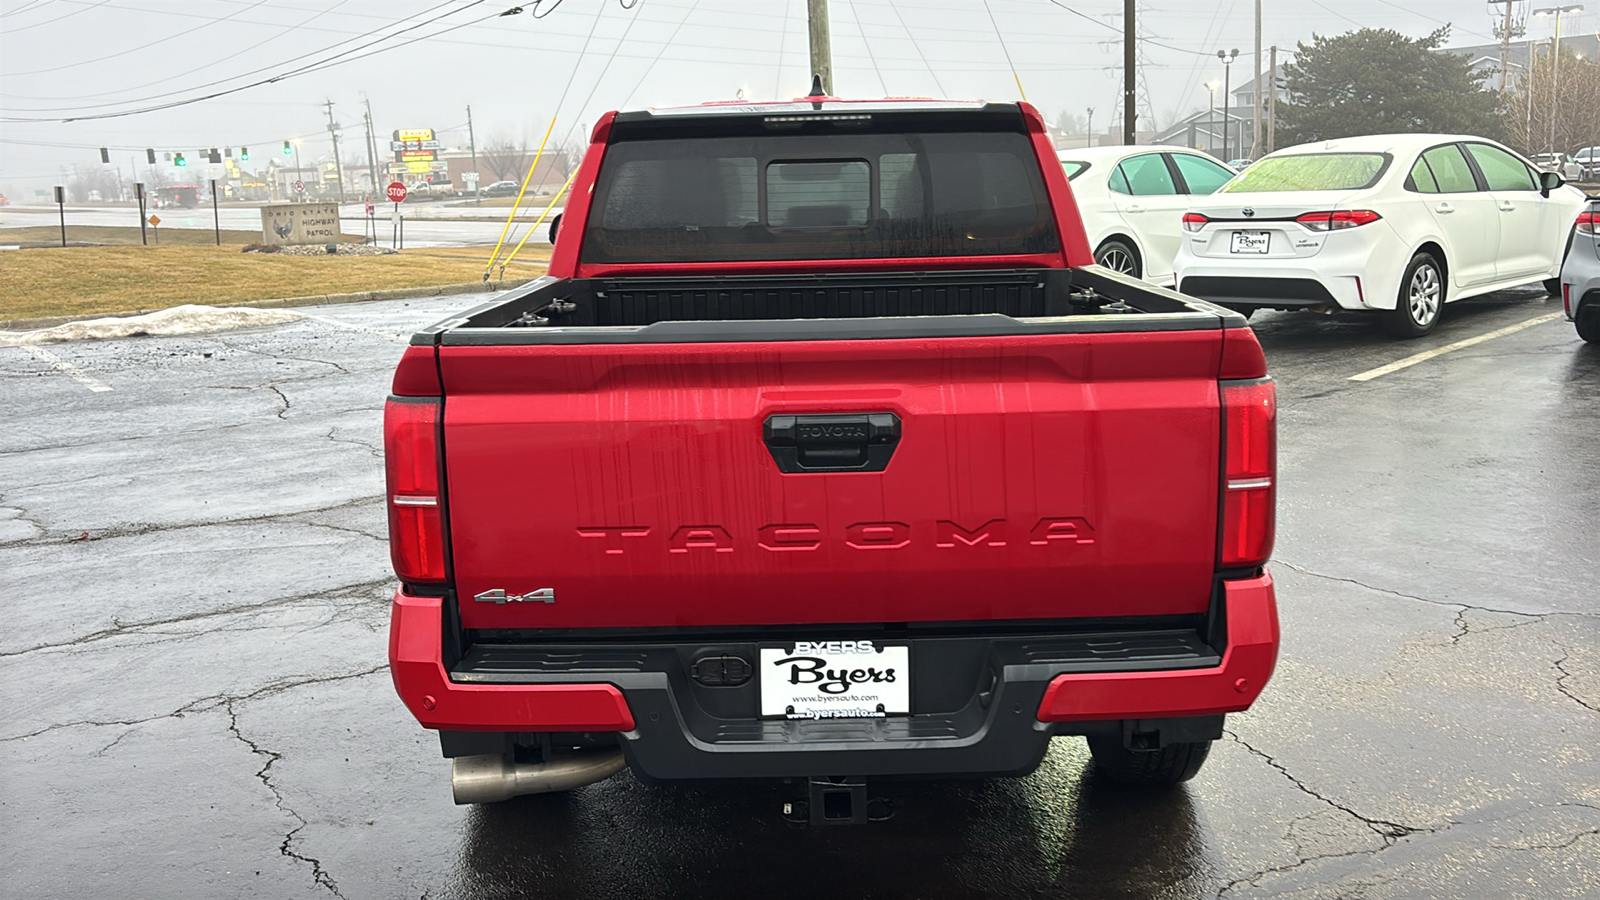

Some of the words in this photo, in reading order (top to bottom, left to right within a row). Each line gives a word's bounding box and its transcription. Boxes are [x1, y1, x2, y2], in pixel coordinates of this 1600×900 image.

[388, 188, 406, 197] STOP
[268, 210, 295, 218] OHIO
[302, 208, 335, 216] STATE
[302, 217, 336, 226] HIGHWAY
[306, 229, 334, 237] PATROL
[1236, 236, 1266, 247] Byers
[800, 425, 865, 438] TOYOTA
[576, 516, 1096, 554] TACOMA
[794, 640, 874, 655] BYERS
[773, 656, 897, 694] Byers
[791, 693, 880, 704] www.byersauto.com
[786, 707, 886, 720] www.byersauto.com
